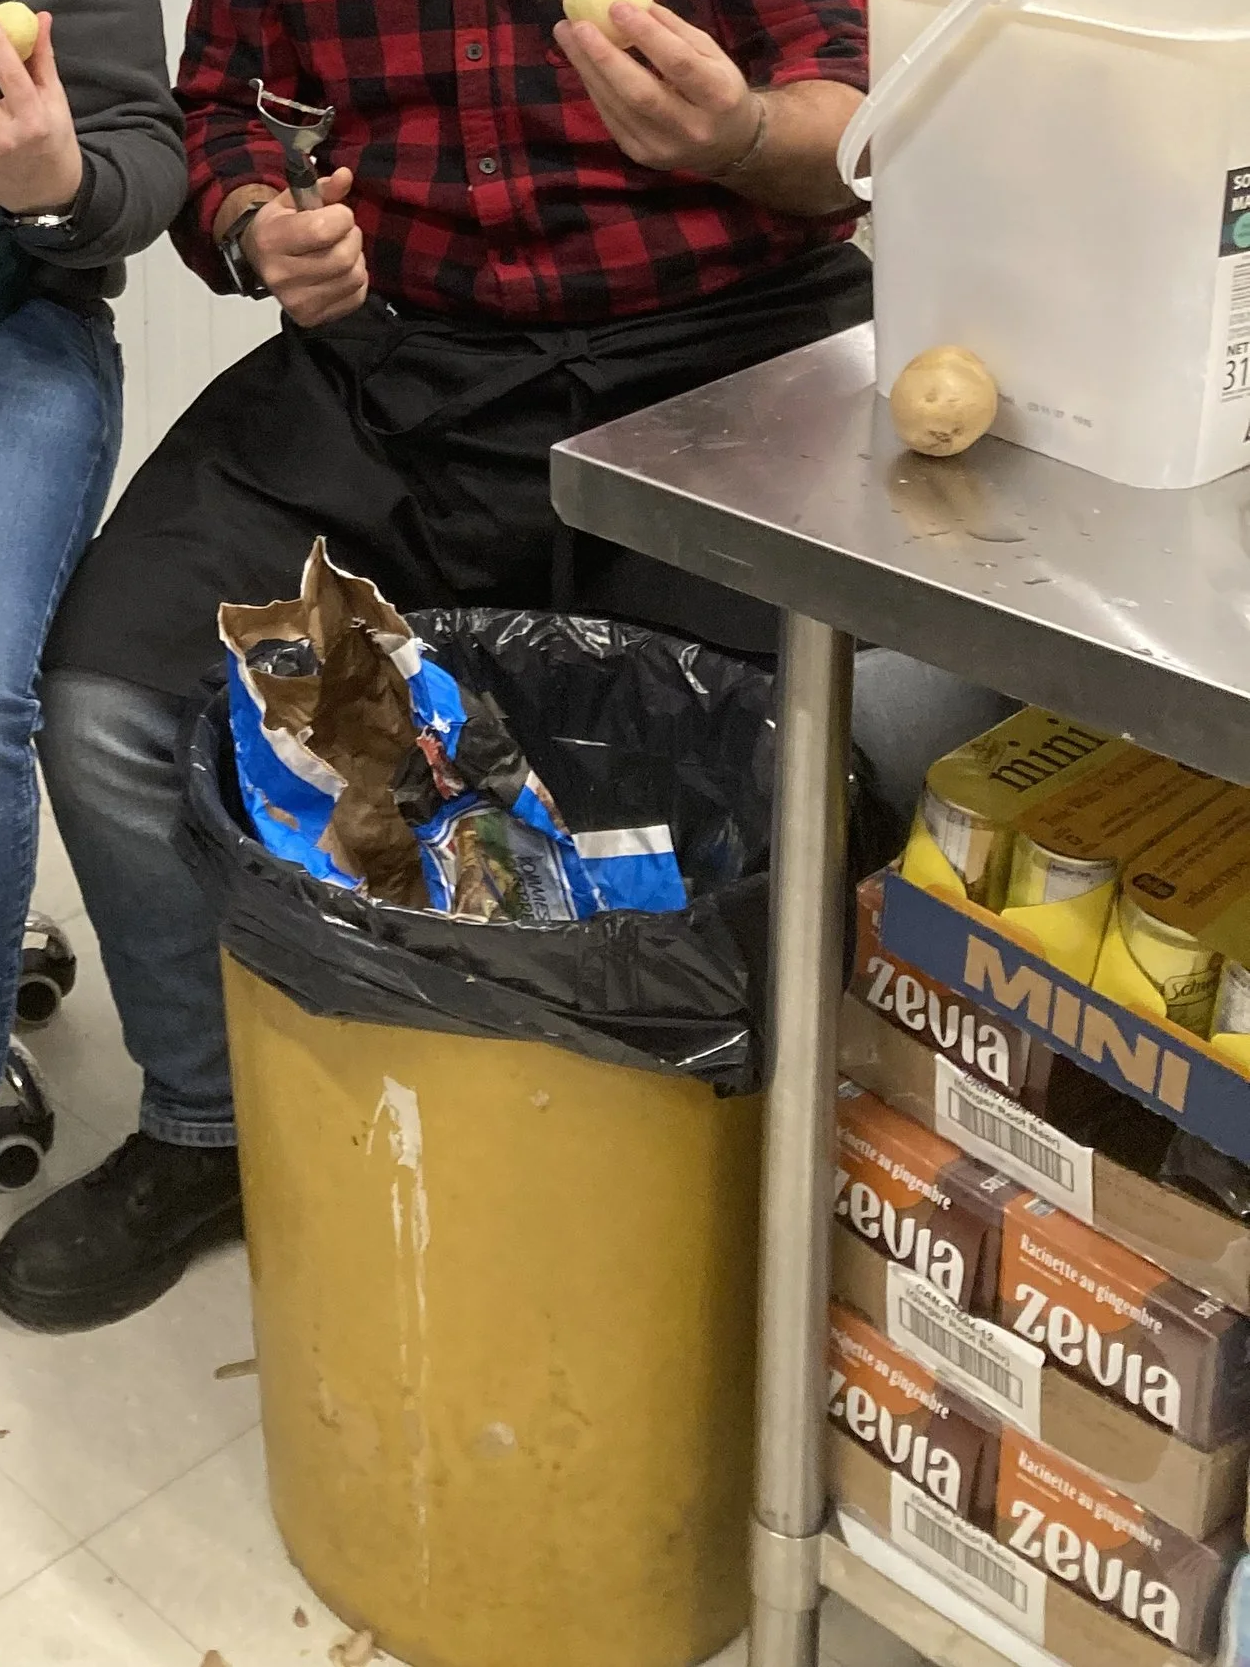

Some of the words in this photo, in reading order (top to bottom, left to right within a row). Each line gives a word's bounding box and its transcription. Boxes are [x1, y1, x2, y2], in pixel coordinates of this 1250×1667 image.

[989, 718, 1109, 793] mini
[866, 956, 1011, 1087] zevia
[963, 934, 1191, 1114] MINI
[1020, 1233, 1079, 1283] Racinette
[1078, 1272, 1096, 1294] au
[1094, 1286, 1164, 1335] gingembre
[1012, 1283, 1182, 1432] zevia
[1017, 1449, 1077, 1501] Racinette
[1076, 1490, 1094, 1511] au
[1093, 1501, 1163, 1553] gingembre
[1008, 1500, 1181, 1645] zevia
